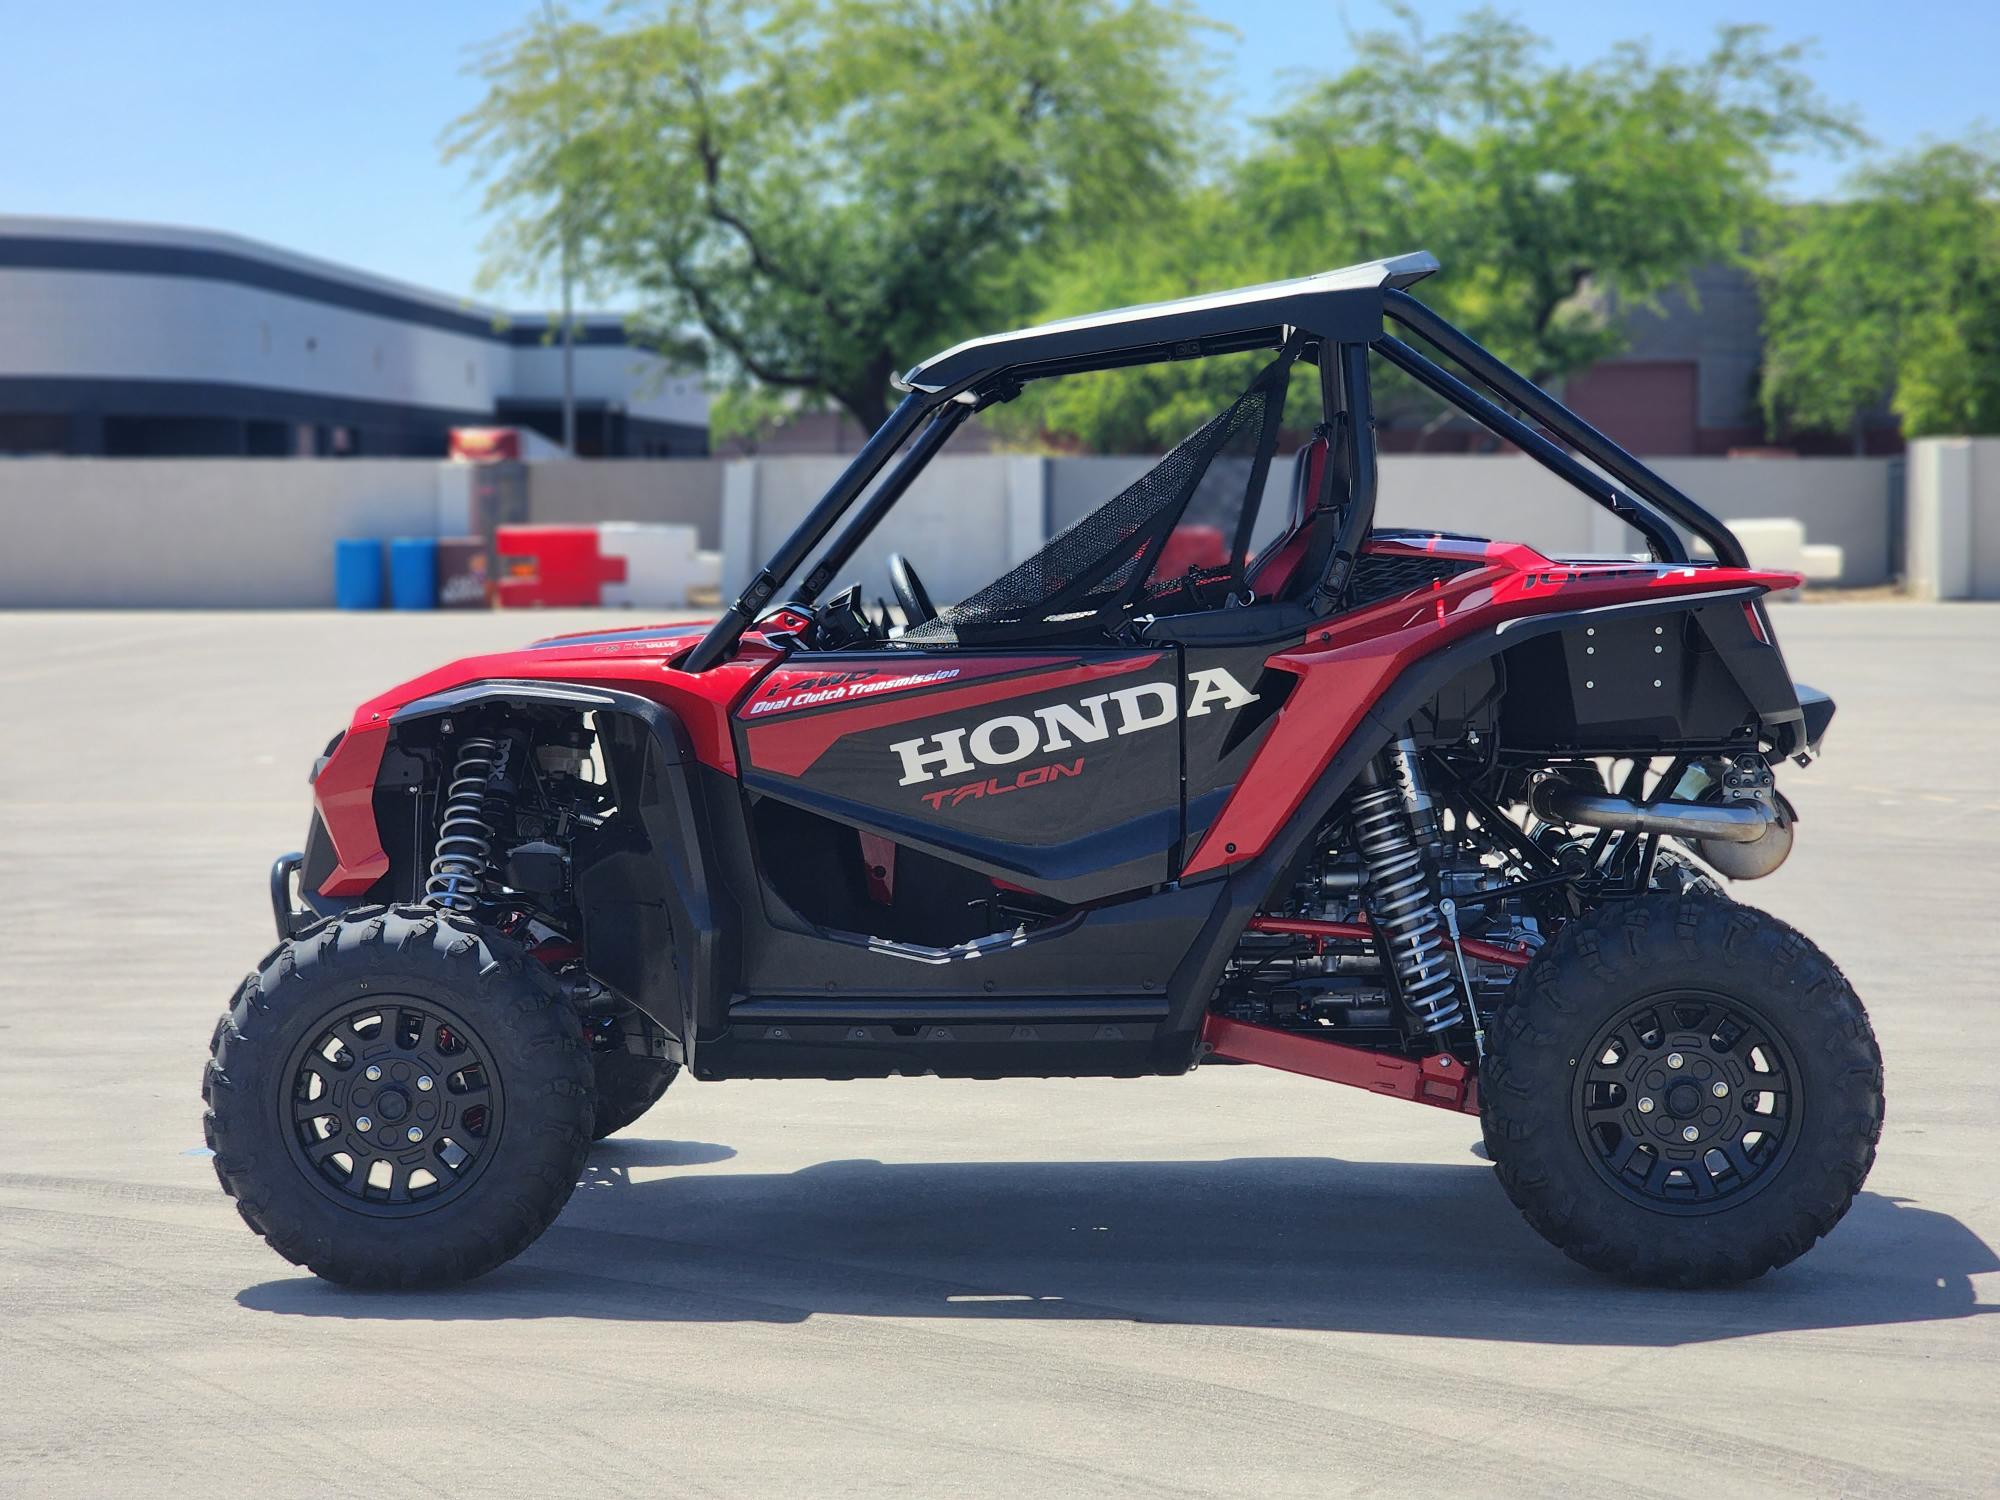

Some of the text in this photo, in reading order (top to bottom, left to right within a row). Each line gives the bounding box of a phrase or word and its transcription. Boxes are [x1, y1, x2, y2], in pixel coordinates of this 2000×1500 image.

[750, 668, 961, 714] Dual Clutch Transmission
[890, 667, 1261, 787] HONDA
[921, 757, 1085, 811] TALON
